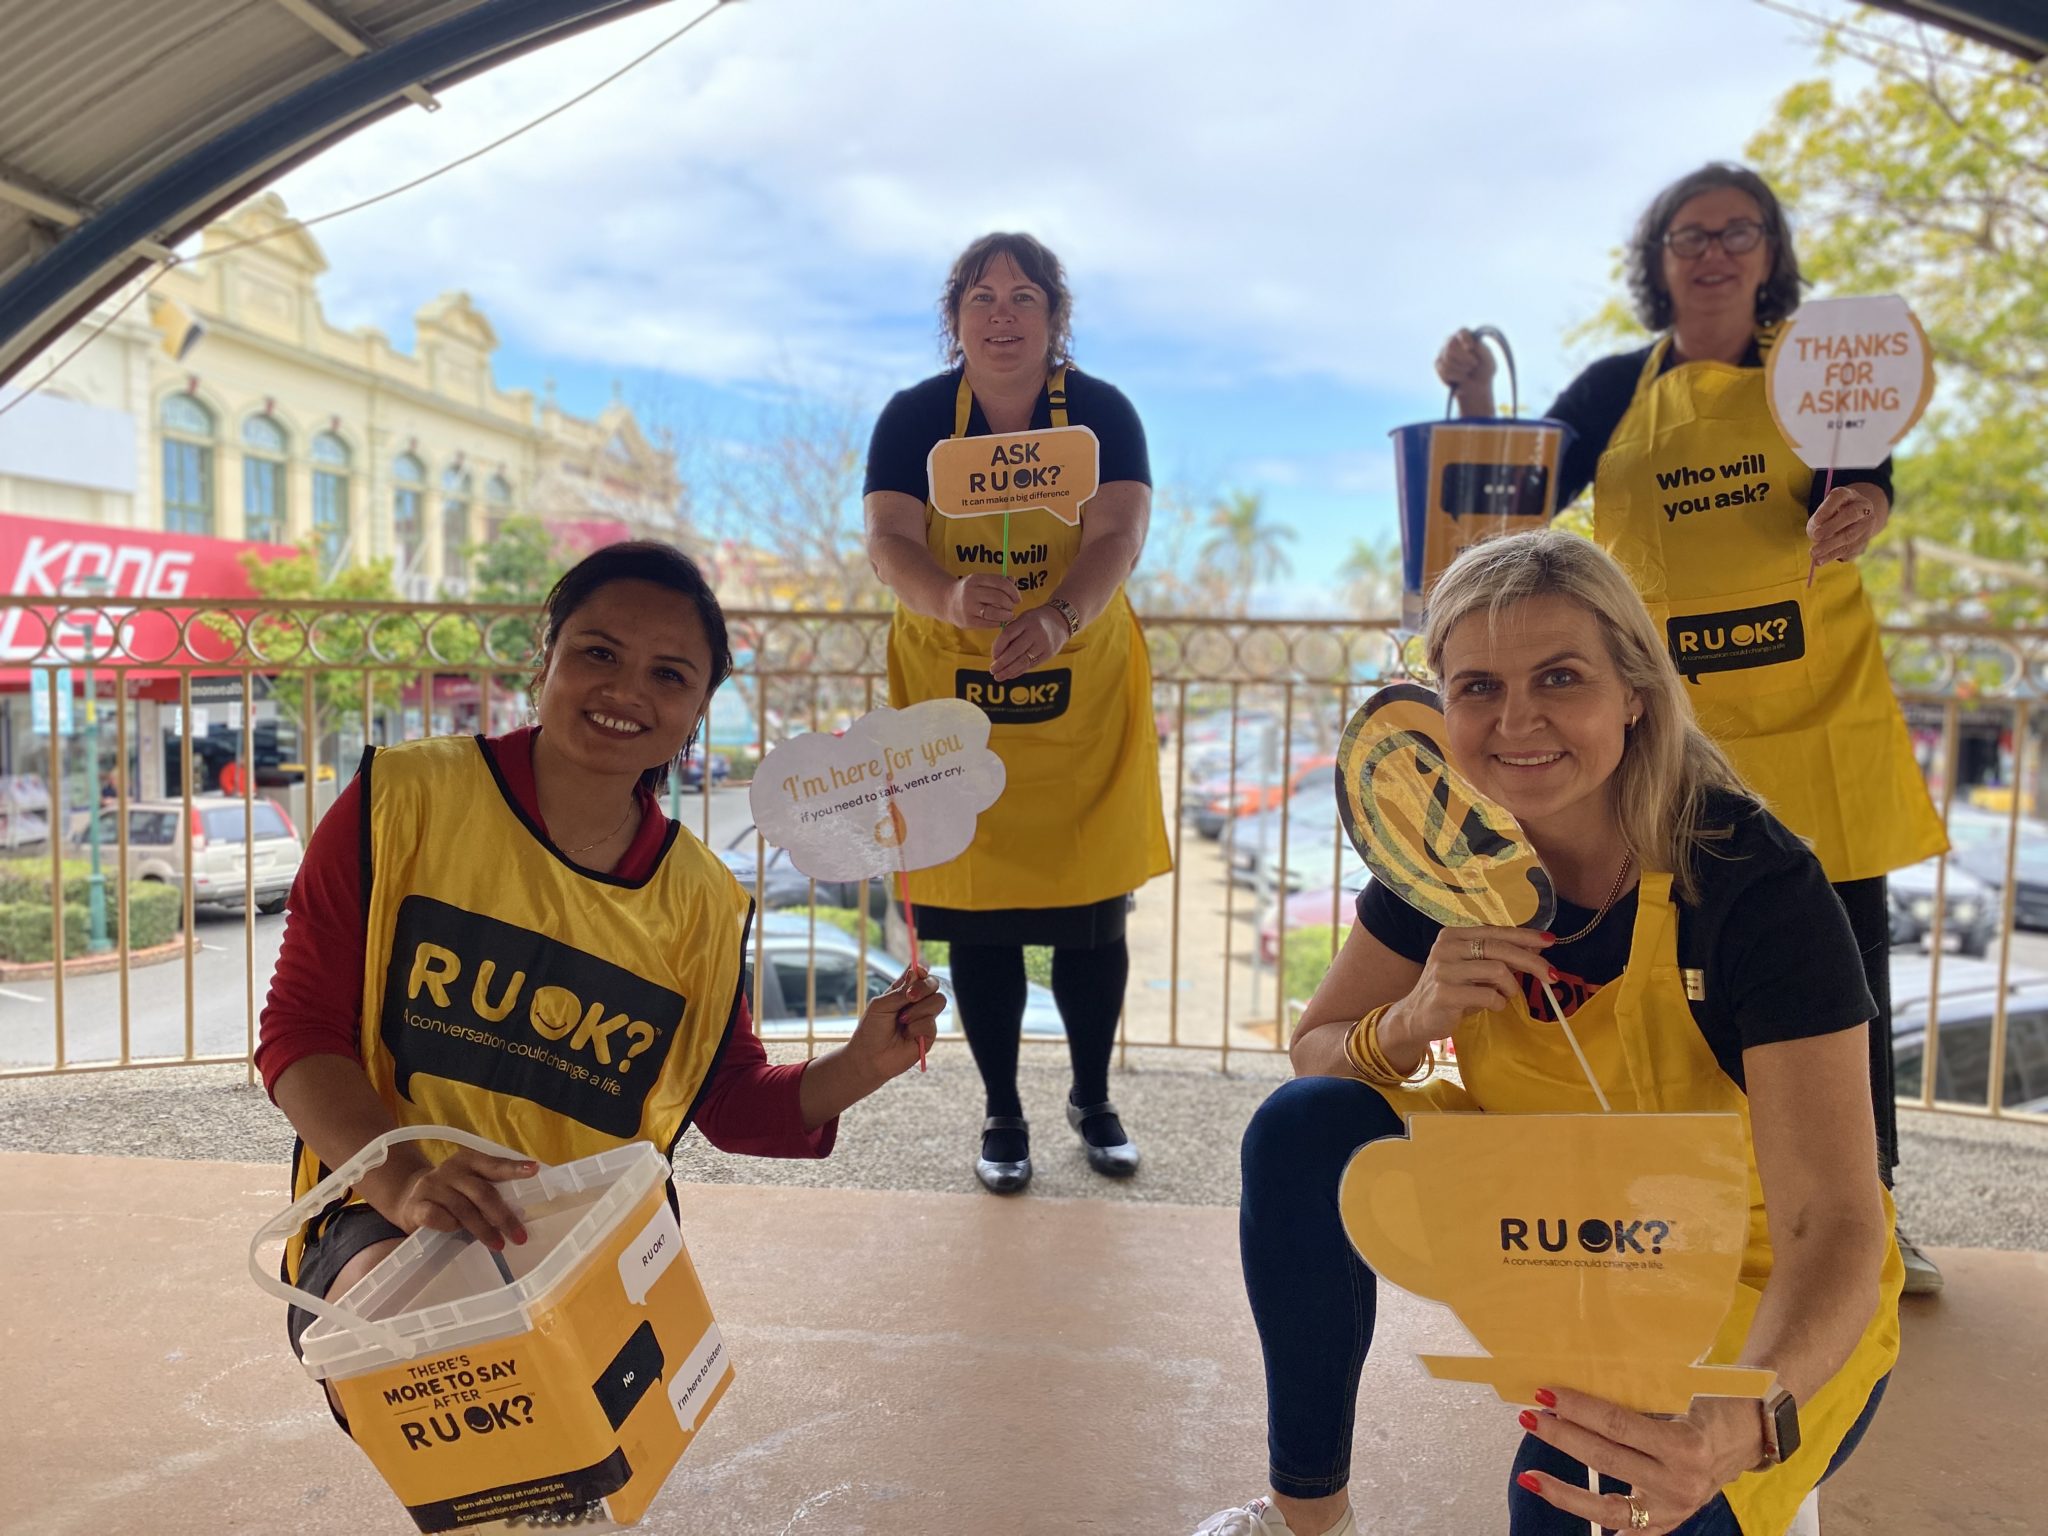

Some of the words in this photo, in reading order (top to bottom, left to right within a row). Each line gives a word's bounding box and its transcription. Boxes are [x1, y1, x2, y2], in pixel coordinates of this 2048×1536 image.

[1795, 332, 1909, 361] THANKS
[1825, 361, 1873, 386] FOR
[1797, 387, 1899, 415] ASKING
[991, 442, 1040, 466] ASK
[970, 473, 986, 493] R
[991, 470, 1008, 491] U
[1656, 466, 1716, 491] Who
[1720, 454, 1766, 479] will
[970, 498, 984, 506] can
[986, 496, 1009, 504] make
[1016, 494, 1029, 503] big
[1029, 490, 1070, 500] difference
[1664, 495, 1710, 522] you
[1715, 483, 1770, 509] ask?
[11, 536, 195, 598] KONG
[956, 544, 1004, 565] Who
[1010, 544, 1048, 565] will
[1014, 570, 1048, 591] sk?
[0, 605, 140, 660] LES
[1680, 631, 1699, 652] R
[1703, 628, 1725, 650] U
[966, 683, 982, 703] R
[987, 684, 1005, 704] U
[782, 775, 829, 803] I'm
[830, 759, 882, 792] here
[884, 746, 914, 781] for
[921, 733, 964, 767] you
[800, 812, 809, 824] if
[811, 806, 833, 822] you
[834, 796, 863, 813] need
[864, 791, 878, 803] to
[879, 784, 904, 799] talk,
[904, 775, 930, 791] vent
[931, 771, 943, 782] or
[944, 764, 966, 779] cry.
[408, 942, 461, 1008] R
[472, 960, 526, 1022] U
[410, 1014, 506, 1050] conversation
[507, 1042, 548, 1062] could
[548, 1050, 590, 1080] change
[589, 1074, 600, 1086] a
[653, 1233, 666, 1253] OK?
[1500, 1218, 1528, 1251] R
[1537, 1219, 1567, 1252] U
[1511, 1258, 1573, 1267] conversation
[1574, 1259, 1600, 1268] could
[1603, 1260, 1640, 1271] change
[407, 1355, 470, 1379] THERE'S
[623, 1370, 635, 1388] No
[677, 1391, 690, 1411] I'm
[688, 1373, 703, 1396] here
[702, 1365, 709, 1377] to
[707, 1343, 722, 1366] listen
[383, 1378, 444, 1406] MORE
[444, 1370, 474, 1390] TO
[476, 1359, 517, 1383] SAY
[433, 1389, 481, 1410] AFTER
[401, 1422, 432, 1451] R
[429, 1413, 461, 1442] U
[453, 1502, 475, 1511] Learn
[475, 1498, 493, 1507] what
[502, 1493, 515, 1502] say
[515, 1490, 522, 1498] at
[463, 1506, 509, 1521] conversation
[509, 1501, 529, 1511] could
[530, 1496, 556, 1507] change
